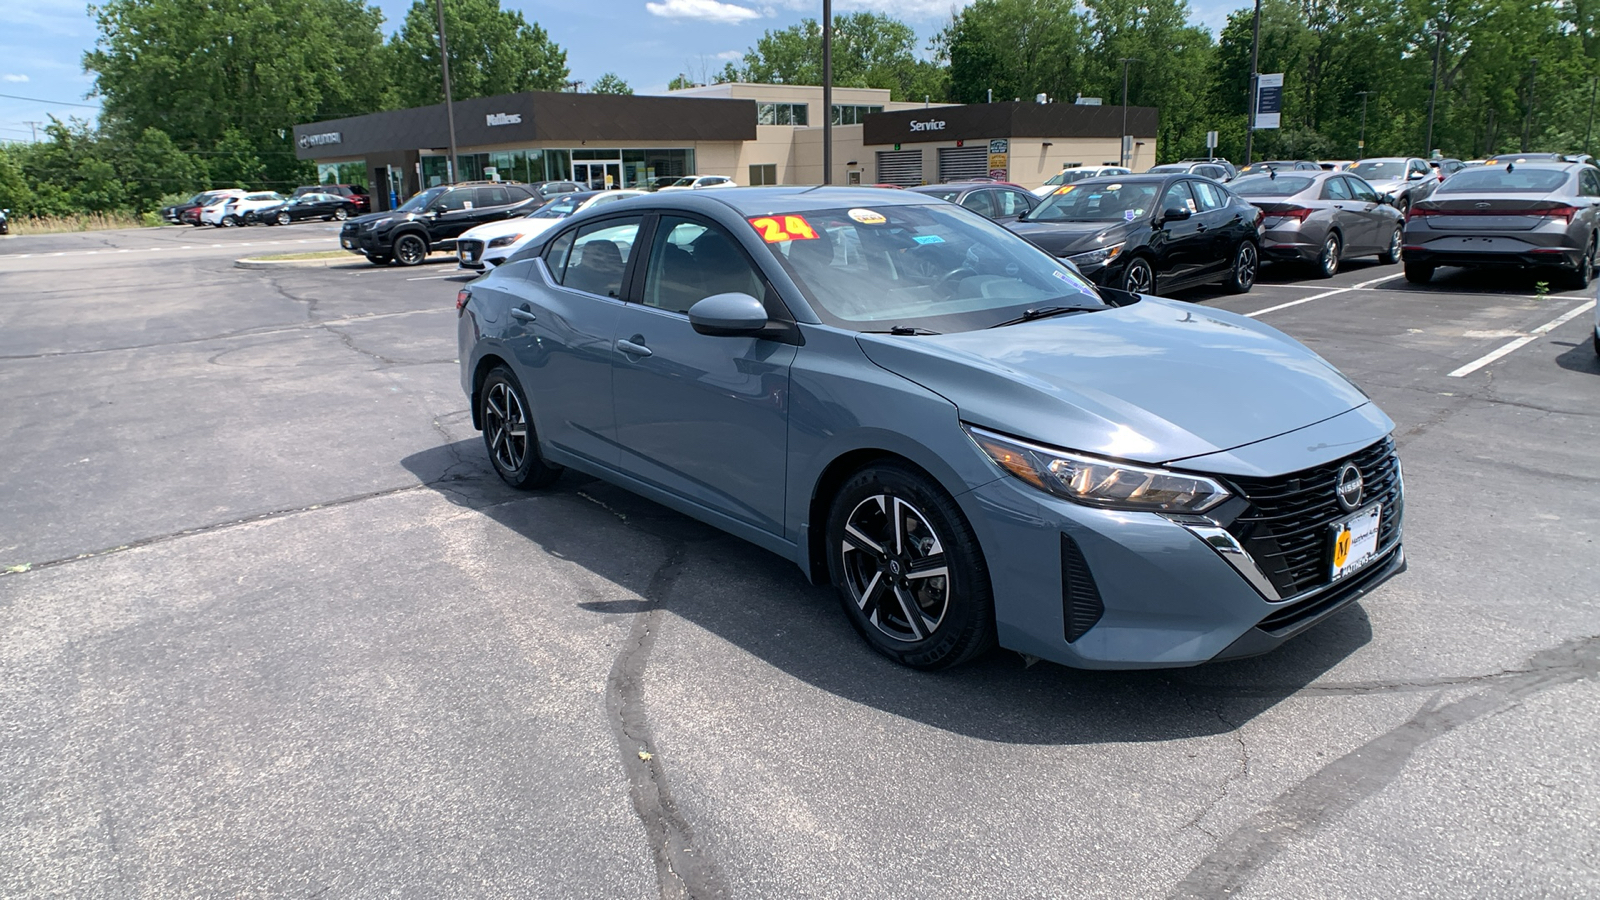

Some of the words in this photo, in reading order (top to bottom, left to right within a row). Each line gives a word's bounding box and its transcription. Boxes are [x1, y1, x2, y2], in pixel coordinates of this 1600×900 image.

[909, 118, 946, 132] Service
[308, 131, 342, 146] HYUNDAI
[753, 215, 814, 241] 24
[1336, 537, 1349, 560] M
